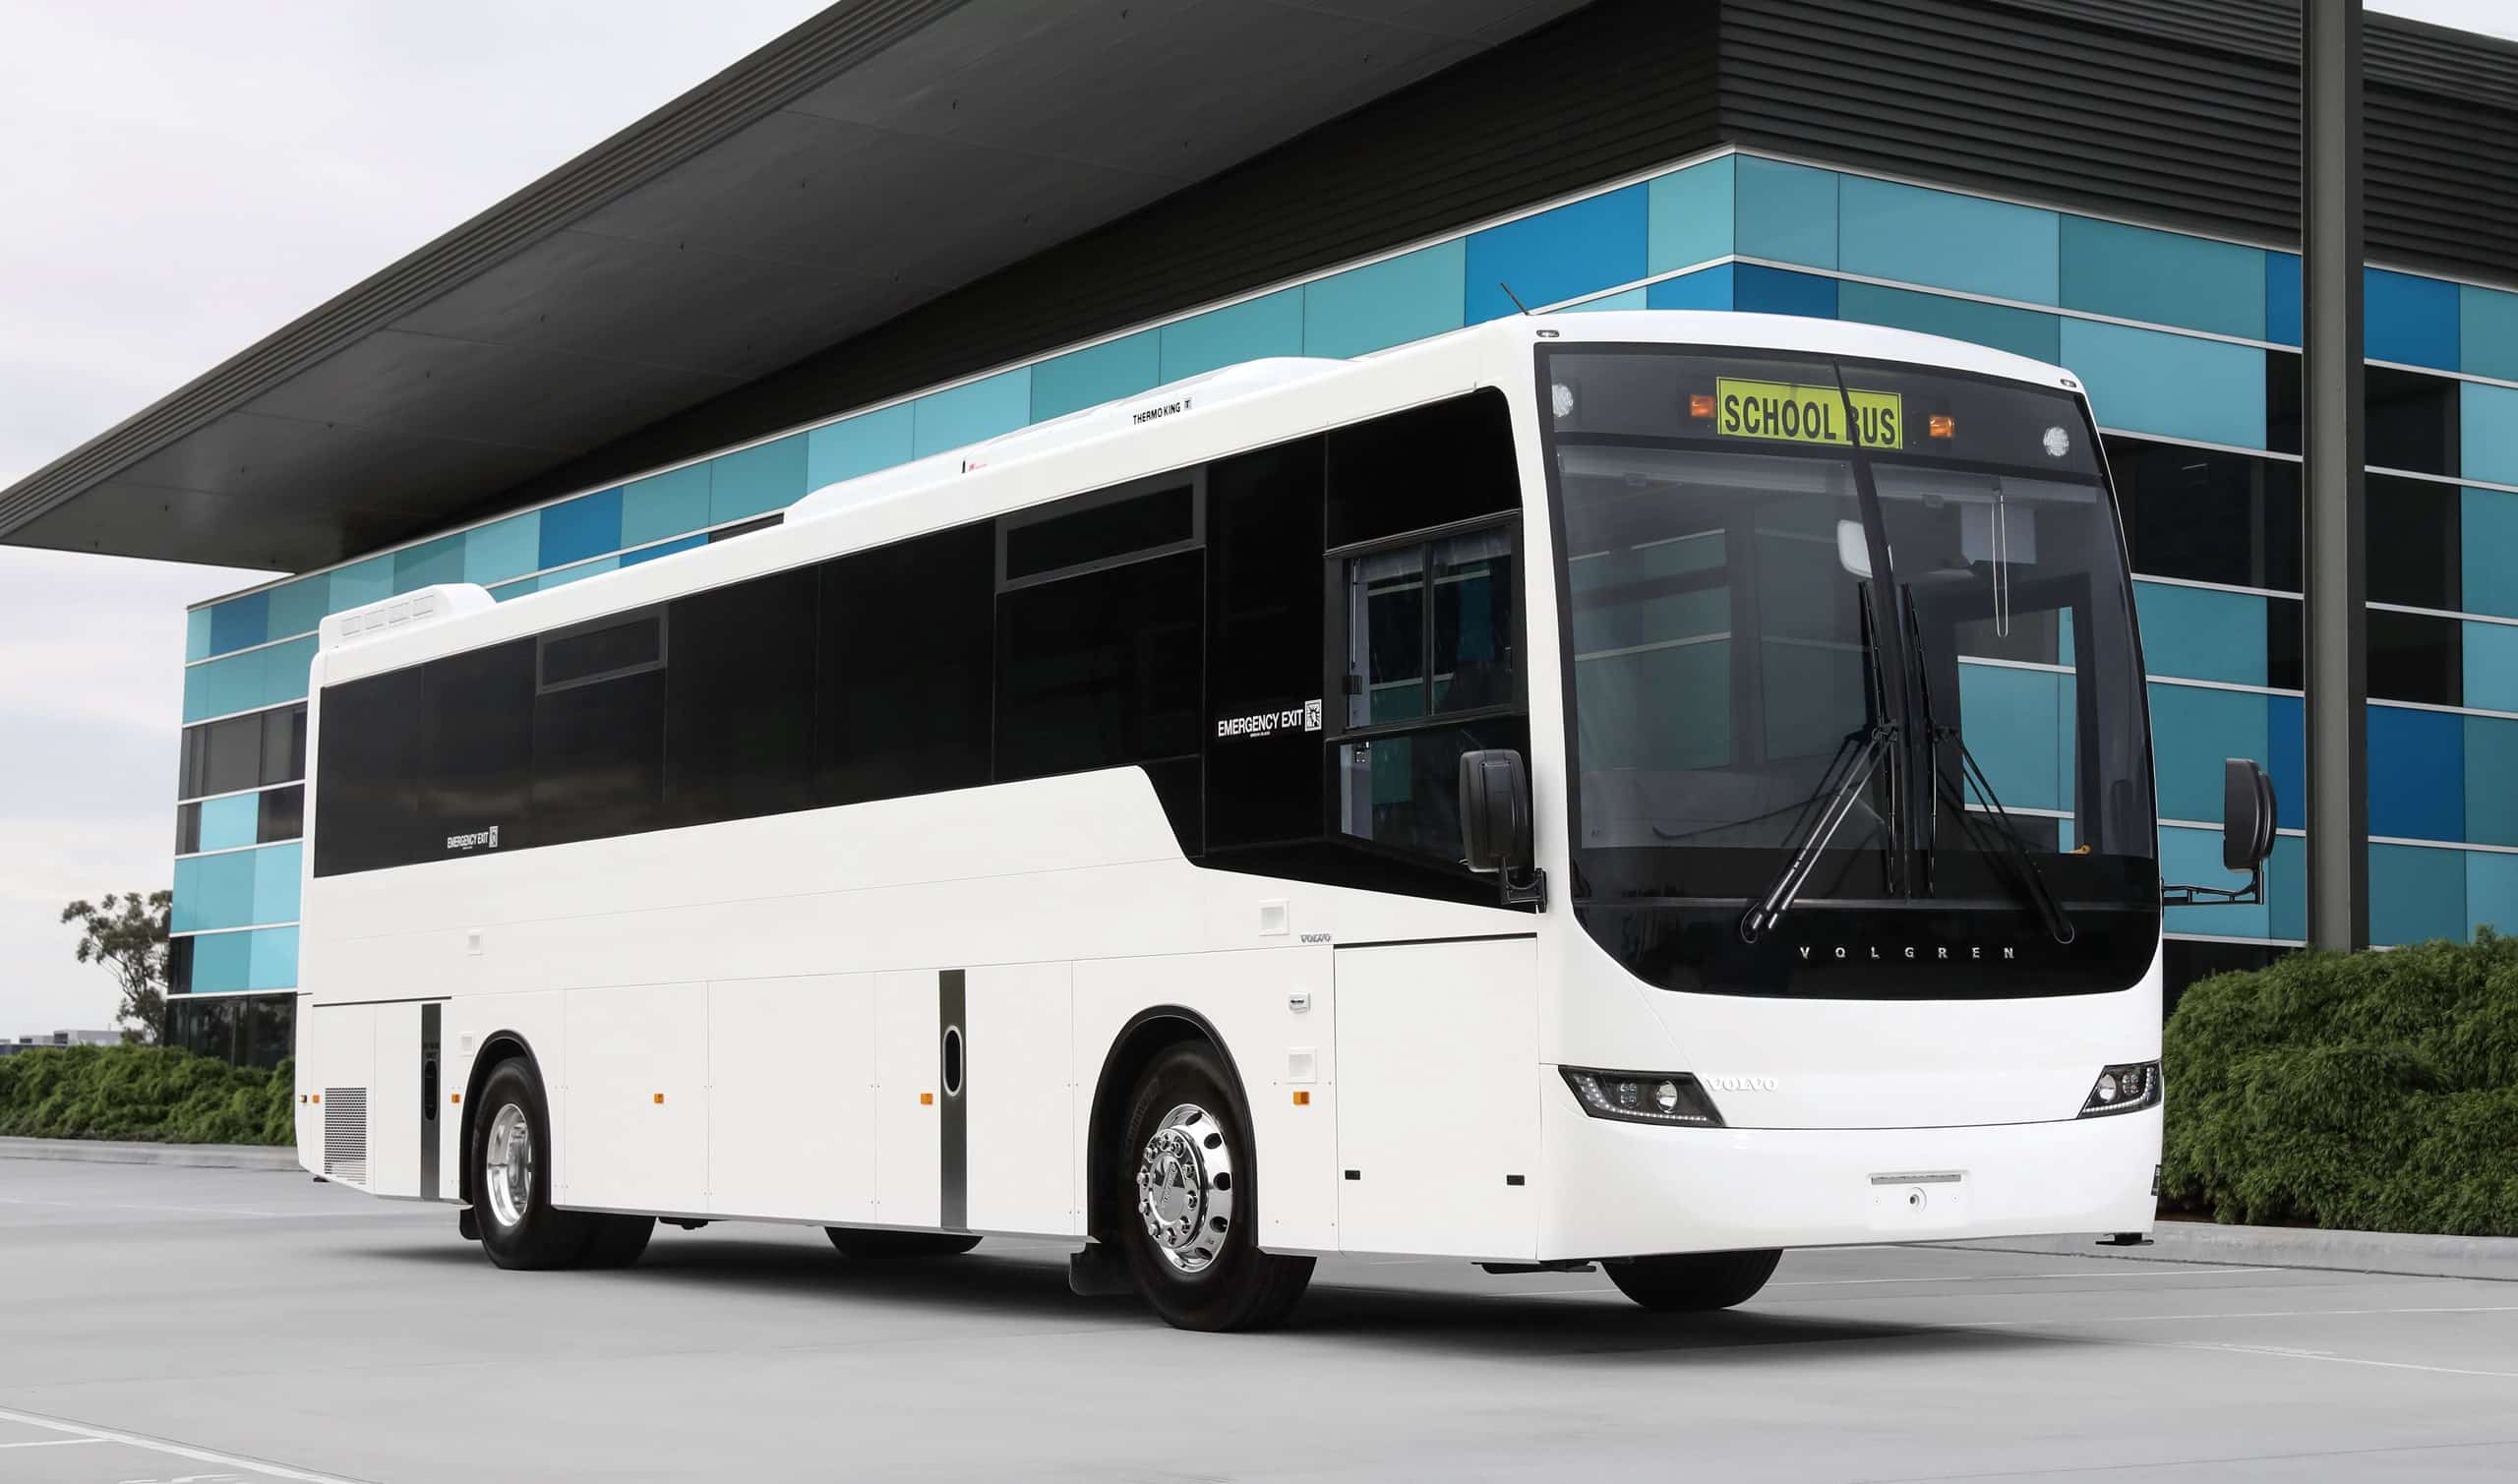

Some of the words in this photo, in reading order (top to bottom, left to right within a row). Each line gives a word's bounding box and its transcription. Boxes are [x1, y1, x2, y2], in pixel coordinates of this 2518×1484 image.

[1133, 407, 1163, 425] THERMO
[1164, 402, 1180, 417] KING
[1724, 394, 1836, 441] SCHOOL
[1845, 404, 1895, 445] BUS
[1218, 712, 1280, 737] EMERGENCY
[1282, 709, 1303, 728] EXIT
[1799, 946, 2014, 960] VOLGREN
[1704, 1077, 1778, 1093] VOLVO
